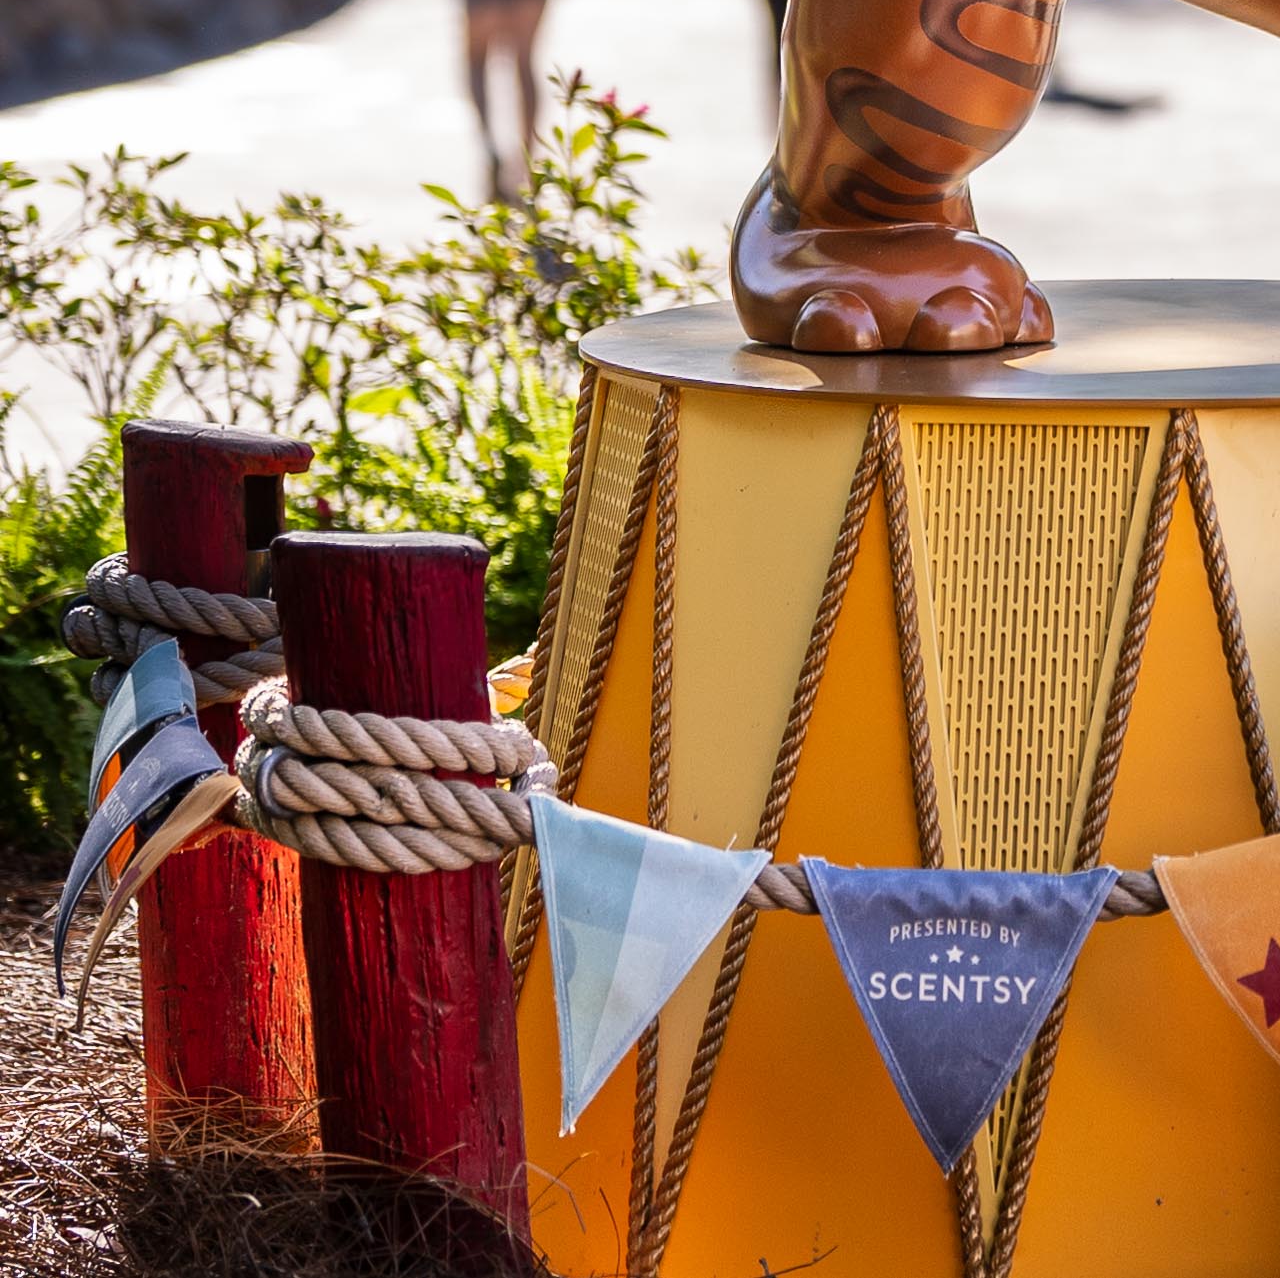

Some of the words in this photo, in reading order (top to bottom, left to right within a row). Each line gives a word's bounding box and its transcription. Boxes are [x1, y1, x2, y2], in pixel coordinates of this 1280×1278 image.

[889, 918, 992, 944] PRESENTED
[999, 924, 1021, 947] BY
[868, 972, 1037, 1005] SCENTSY
